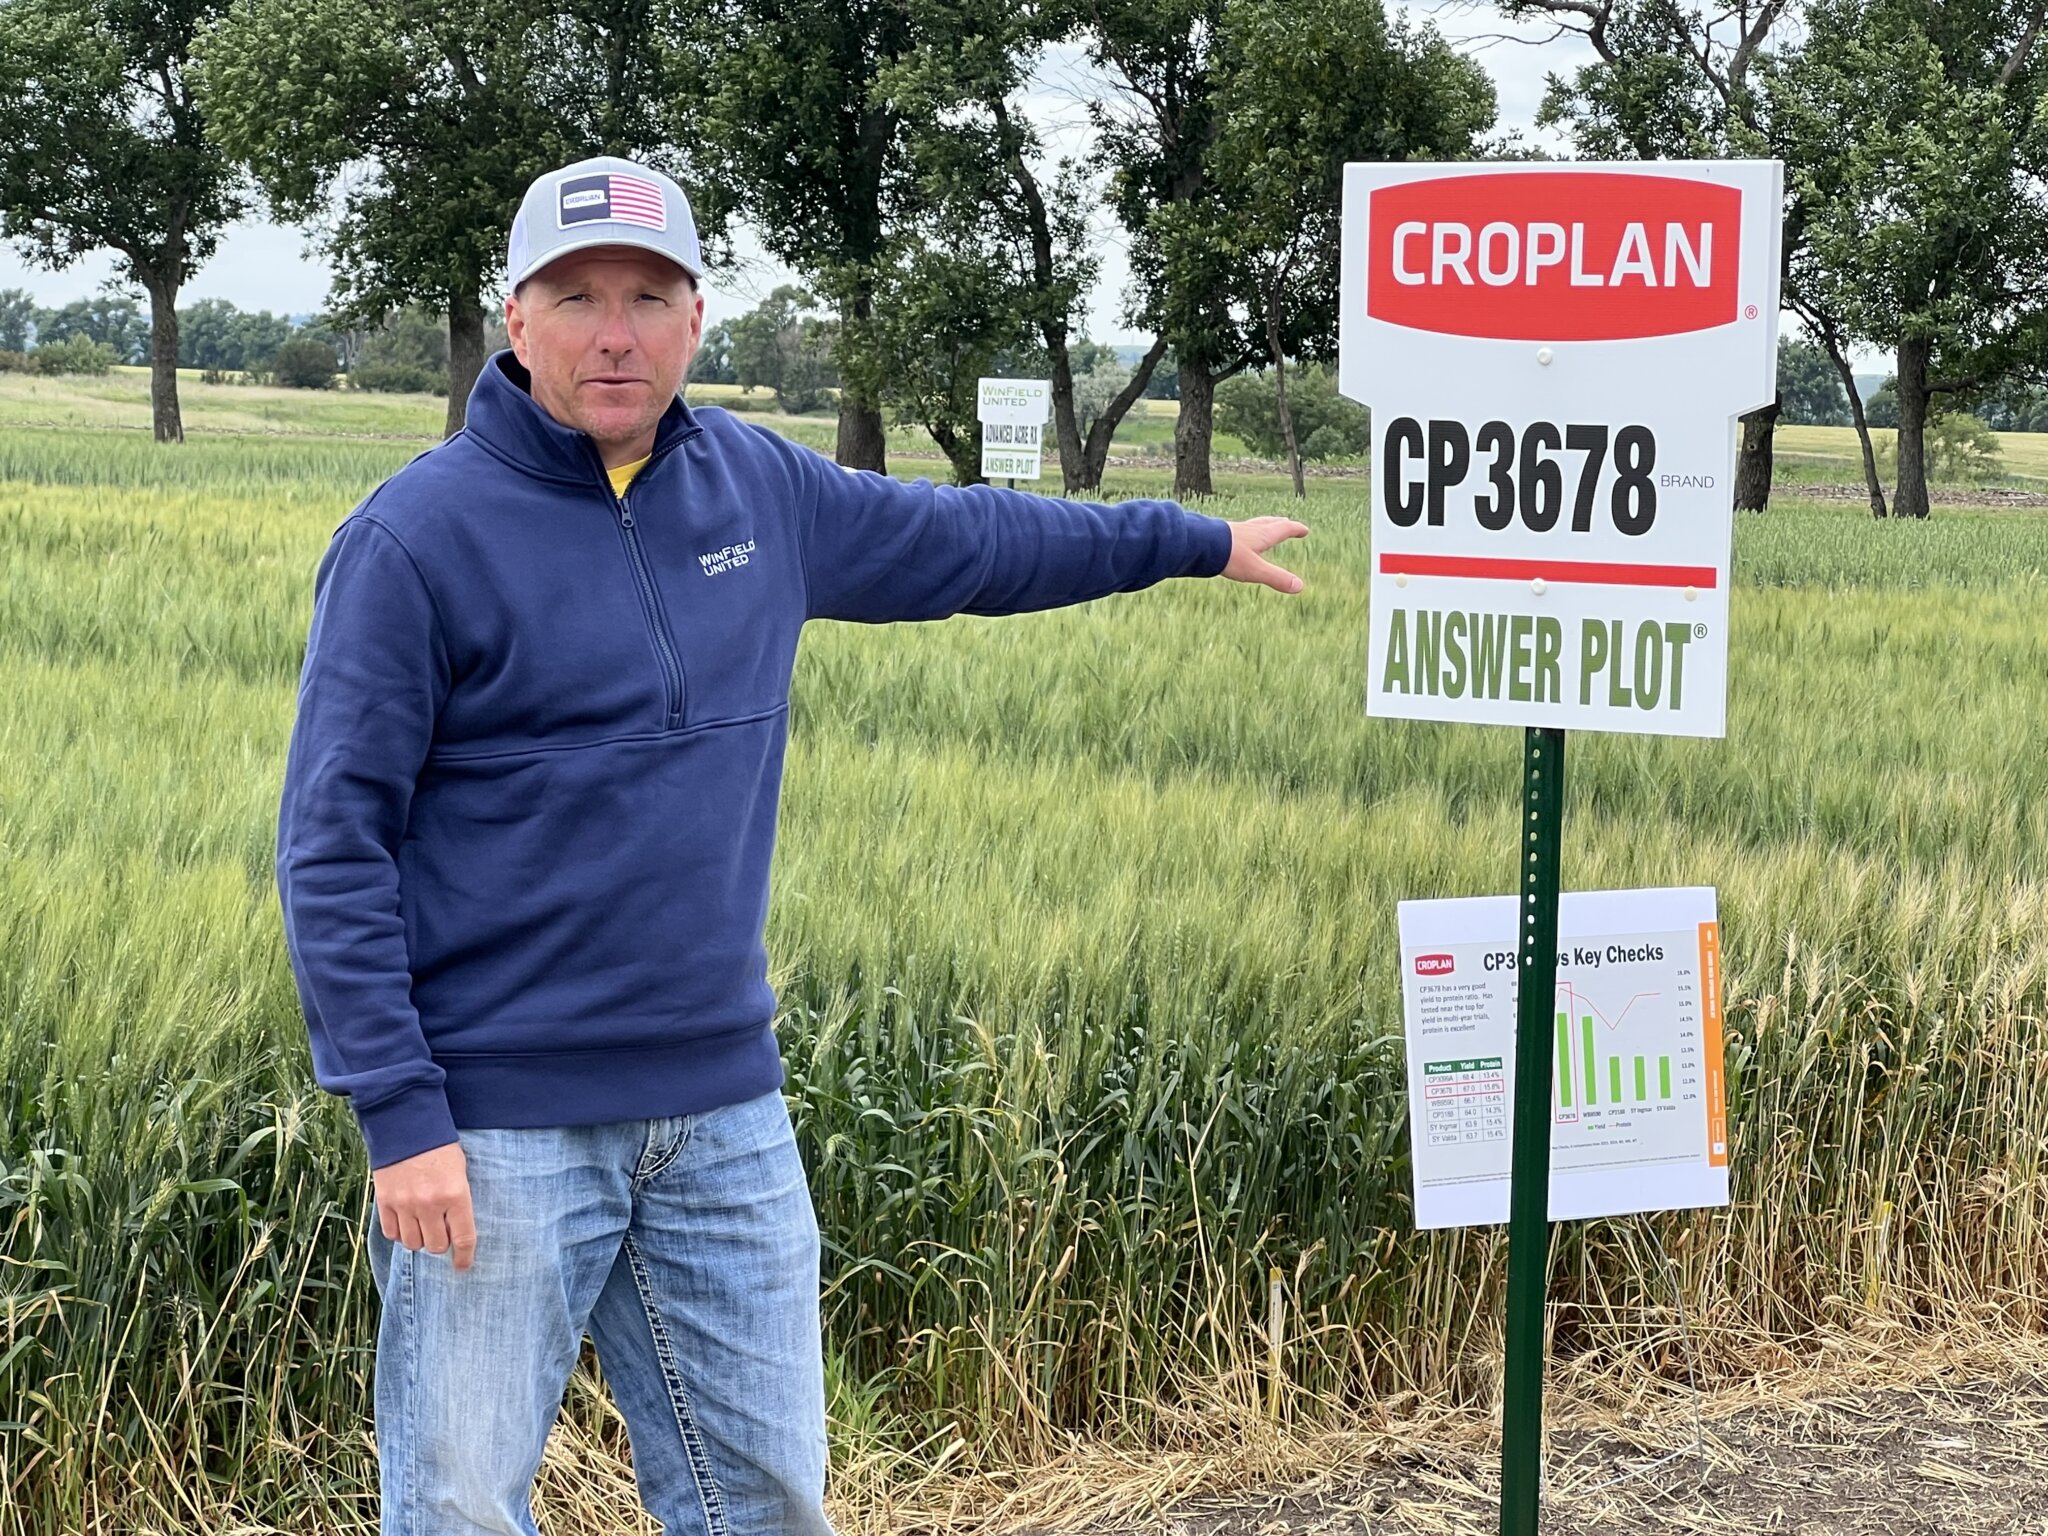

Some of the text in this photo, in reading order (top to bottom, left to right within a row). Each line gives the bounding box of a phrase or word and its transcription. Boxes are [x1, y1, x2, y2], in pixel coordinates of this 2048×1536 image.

[1391, 221, 1713, 287] CROPLAN
[982, 397, 1027, 407] UNITED
[985, 424, 1038, 444] ADVANCED ACRE RX
[984, 457, 1034, 474] ANSWER PLOT
[1383, 416, 1715, 536] CP3678 BRAND
[703, 554, 750, 577] UNITED
[1382, 608, 1562, 704] ANSWER
[1483, 951, 1517, 971] CP3
[1574, 947, 1602, 968] Key
[1606, 944, 1664, 964] Checks
[1416, 959, 1453, 971] CROPLAN
[1420, 985, 1441, 993] CP3678
[1458, 985, 1470, 993] very
[1472, 982, 1486, 992] good
[1420, 996, 1434, 1005] yield
[1443, 994, 1463, 1003] protein
[1421, 1005, 1439, 1013] tested
[1465, 1004, 1475, 1012] top
[1476, 1002, 1485, 1010] for
[1421, 1016, 1435, 1025] yield
[1422, 1026, 1443, 1035] protein
[1450, 1024, 1476, 1032] excellent
[1428, 1060, 1501, 1073] Product Yield Protein
